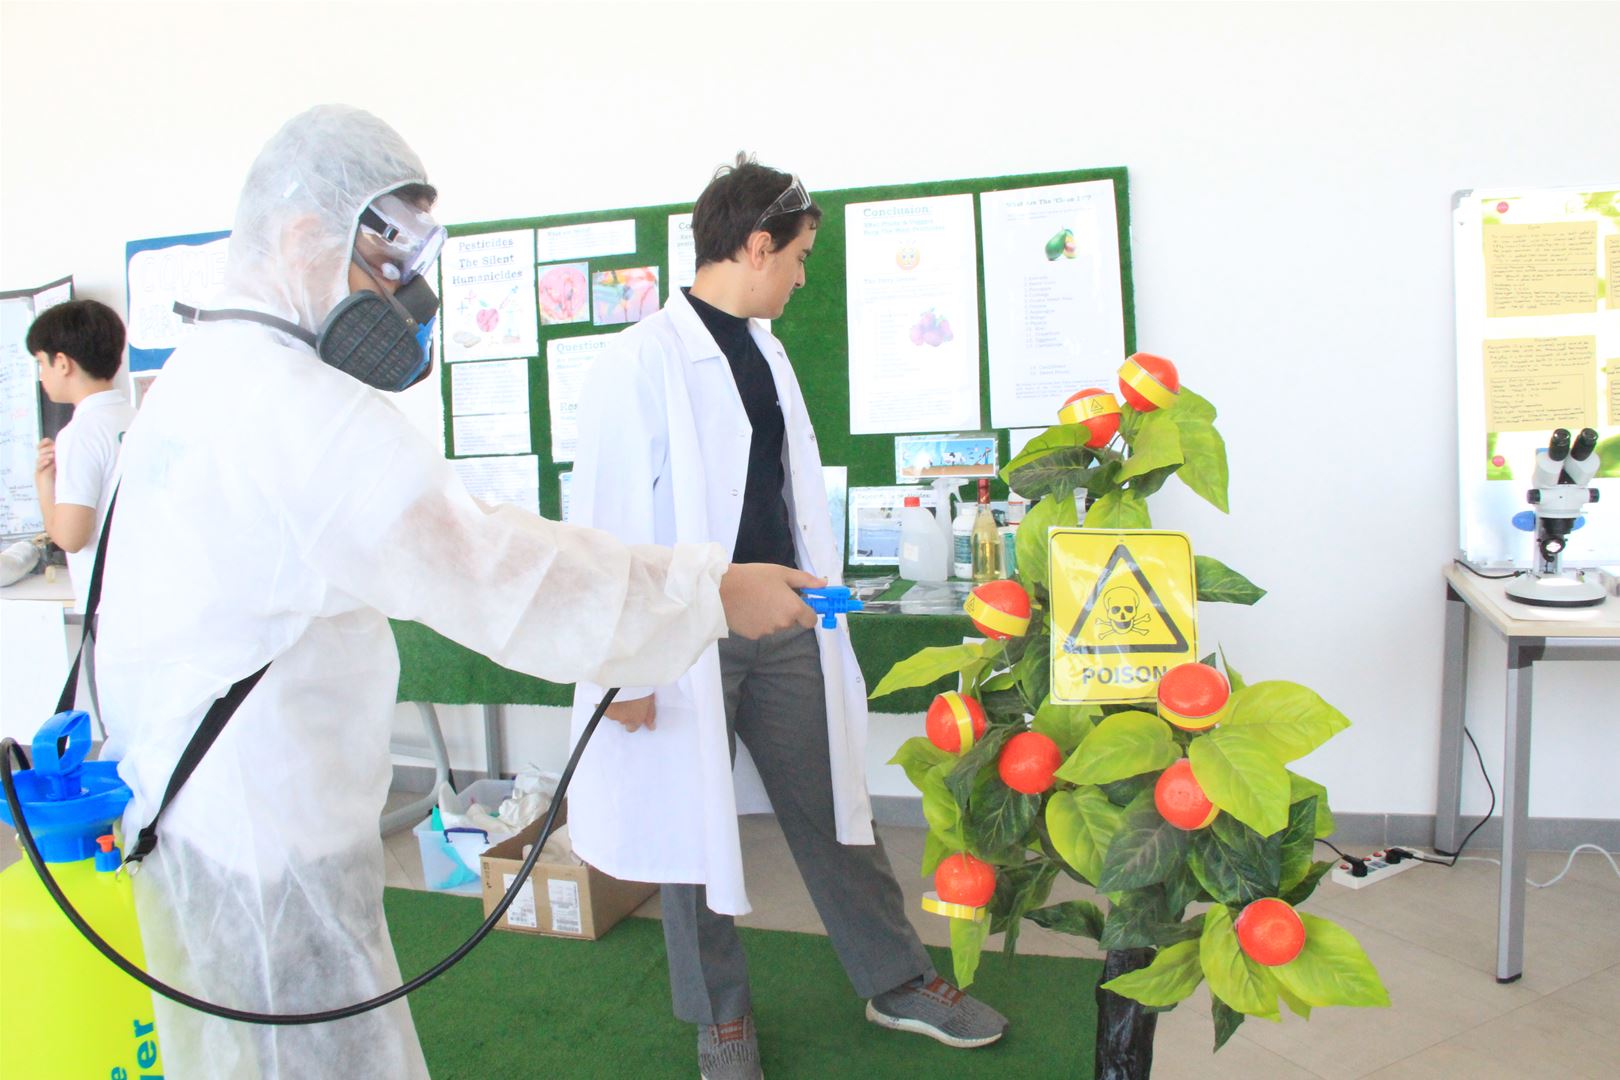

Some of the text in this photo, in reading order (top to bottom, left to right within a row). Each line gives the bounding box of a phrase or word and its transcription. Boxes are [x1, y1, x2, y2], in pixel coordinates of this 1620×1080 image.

[458, 237, 515, 251] Pesticides
[458, 253, 515, 269] The Silent
[452, 269, 524, 285] Humanicides
[1082, 665, 1168, 685] POISON
